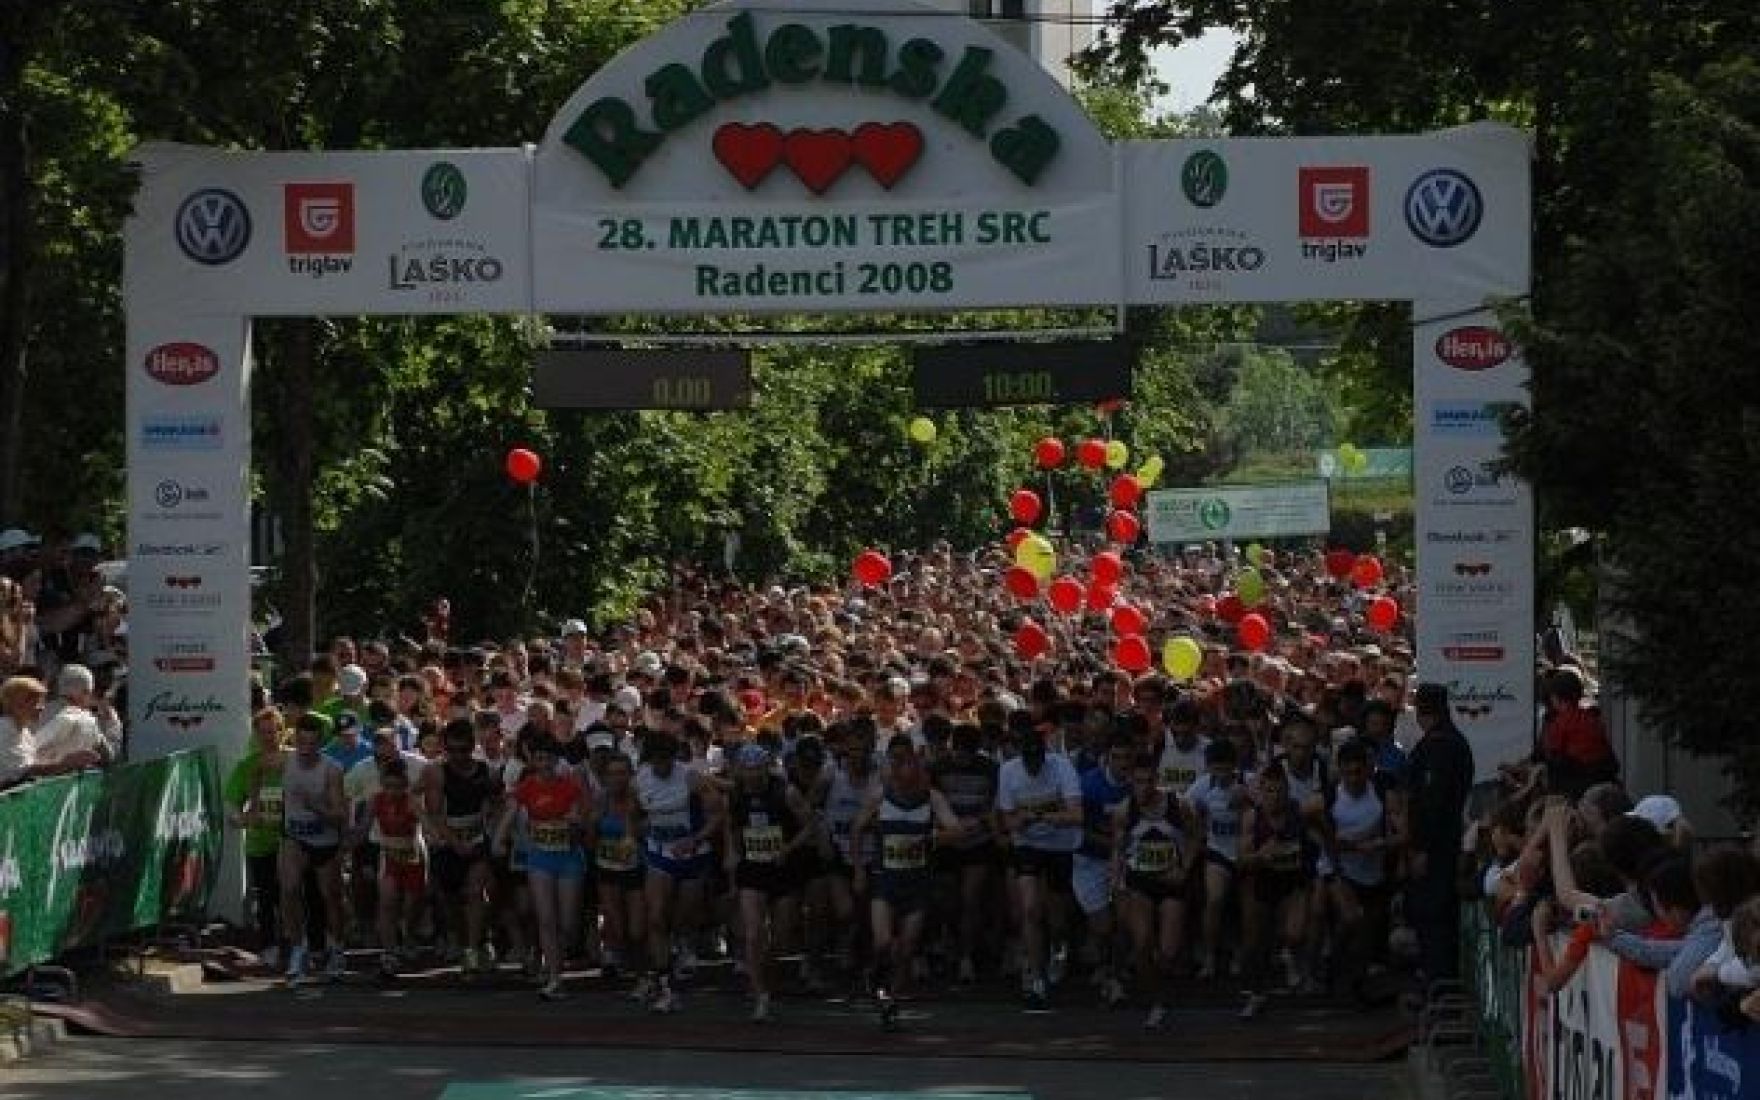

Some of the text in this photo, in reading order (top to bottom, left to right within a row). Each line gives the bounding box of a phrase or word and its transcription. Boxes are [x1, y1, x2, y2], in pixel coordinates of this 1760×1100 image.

[564, 11, 1060, 190] Radenska
[598, 211, 1051, 249] 28. MARATON TREH SRC
[289, 255, 354, 277] triglav
[1146, 241, 1265, 279] LAŠKO
[1301, 241, 1367, 263] triglav
[389, 253, 503, 290] LAŠKO
[698, 261, 954, 297] Radenci 2008
